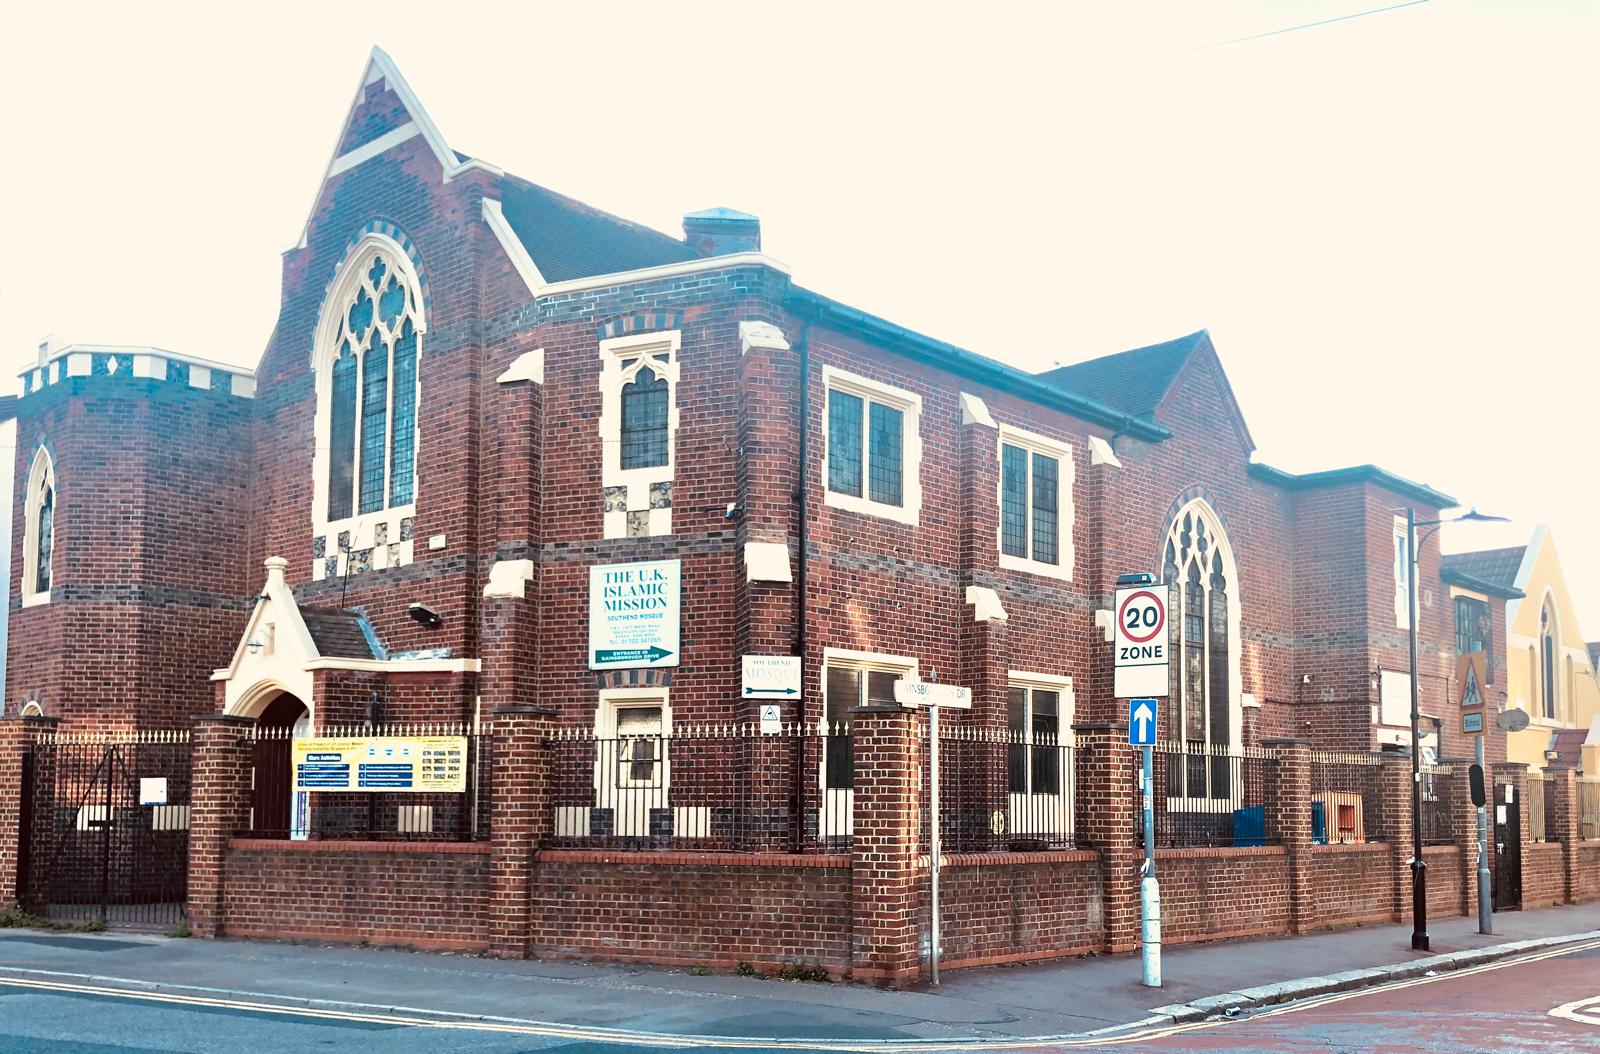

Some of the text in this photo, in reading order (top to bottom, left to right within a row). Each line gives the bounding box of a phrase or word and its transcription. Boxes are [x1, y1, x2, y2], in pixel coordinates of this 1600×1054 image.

[604, 568, 668, 584] THE U.K.
[604, 582, 669, 598] ISLAMIC
[604, 596, 668, 612] MISSION
[1126, 606, 1158, 629] 20
[601, 653, 643, 661] GAINSBOROUGH
[1120, 645, 1163, 660] ZONE
[744, 667, 801, 684] MOSQUE
[956, 688, 967, 699] DR
